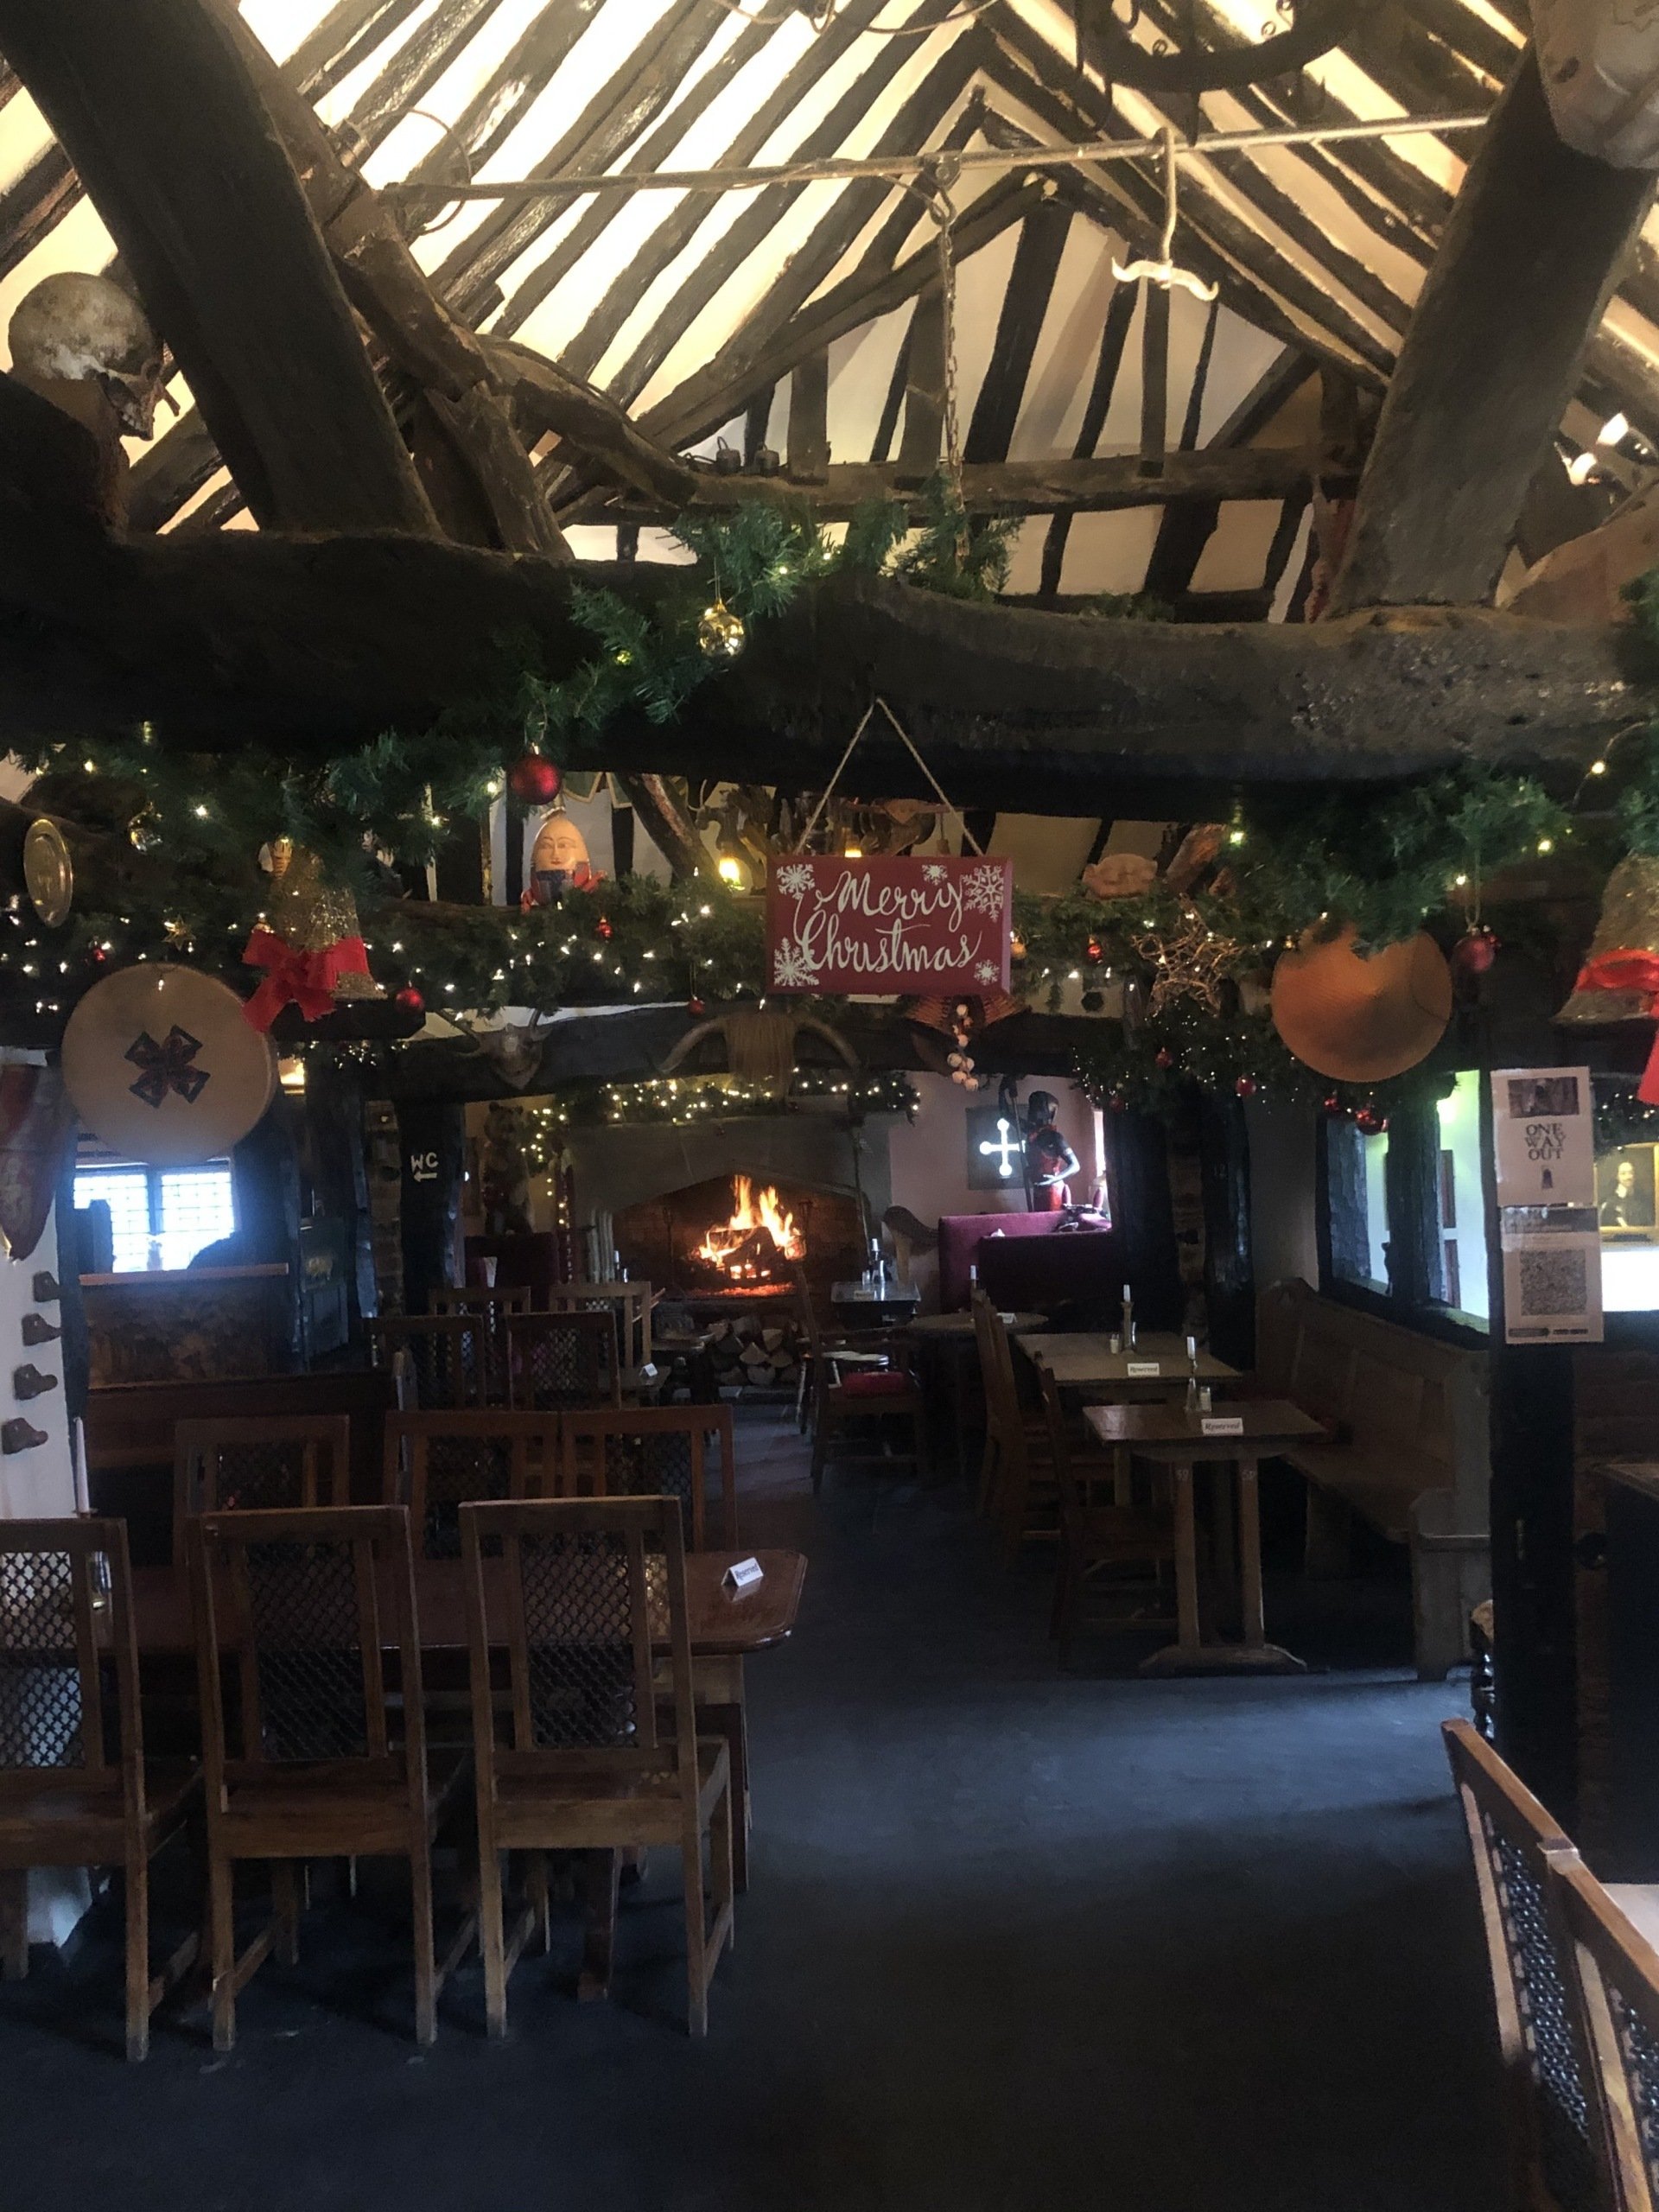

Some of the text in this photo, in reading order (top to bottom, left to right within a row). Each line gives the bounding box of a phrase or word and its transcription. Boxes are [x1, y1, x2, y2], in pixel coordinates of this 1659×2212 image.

[814, 870, 963, 932] Merry
[793, 895, 982, 973] Christmas
[1526, 1123, 1562, 1135] ONE
[1524, 1133, 1566, 1147] WAY
[410, 1152, 439, 1173] WC
[1529, 1148, 1564, 1160] OUT
